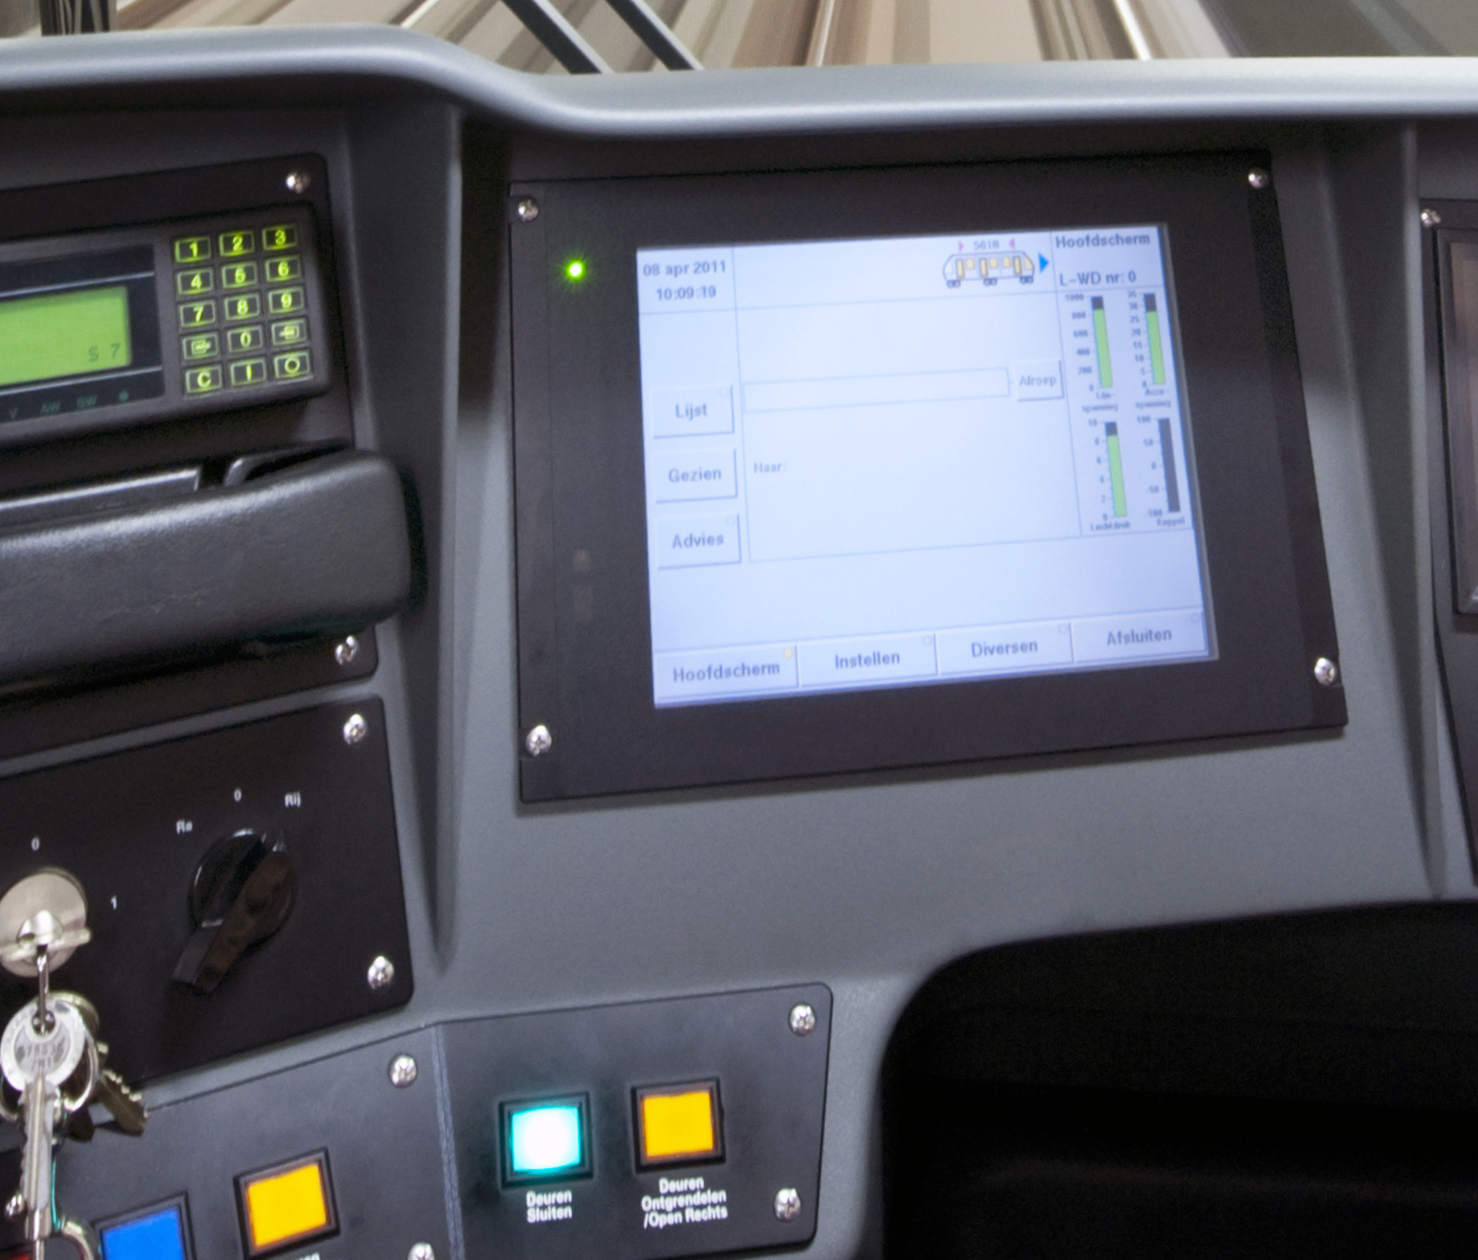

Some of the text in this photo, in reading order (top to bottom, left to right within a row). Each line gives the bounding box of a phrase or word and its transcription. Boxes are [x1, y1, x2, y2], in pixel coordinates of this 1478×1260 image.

[232, 234, 244, 252] 2
[274, 229, 286, 246] 3
[1056, 234, 1151, 249] Hoofdscherm
[189, 241, 199, 258] 1
[278, 260, 290, 278] 6
[643, 259, 726, 278] 08 apr 2011
[191, 273, 202, 290] 4
[1060, 271, 1101, 286] L-WD
[1128, 270, 1136, 282] 0
[237, 298, 249, 316] 8
[281, 292, 293, 310] 9
[193, 305, 204, 323] 7
[240, 331, 252, 348] 0
[110, 343, 121, 358] 7
[197, 371, 211, 388] C
[675, 403, 708, 421] Lijst
[668, 467, 722, 484] Gezien
[672, 533, 724, 549] Advies
[1107, 628, 1172, 646] Afsluiten
[971, 640, 1038, 658] Diversen
[835, 650, 901, 670] Instellen
[673, 660, 781, 683] Hoofdscherm
[659, 1177, 704, 1194] Deuren
[527, 1190, 572, 1208] Deuren
[641, 1189, 727, 1212] Ontgrendelen
[527, 1205, 572, 1223] Sluiten
[644, 1205, 728, 1229] /Open Rechts
